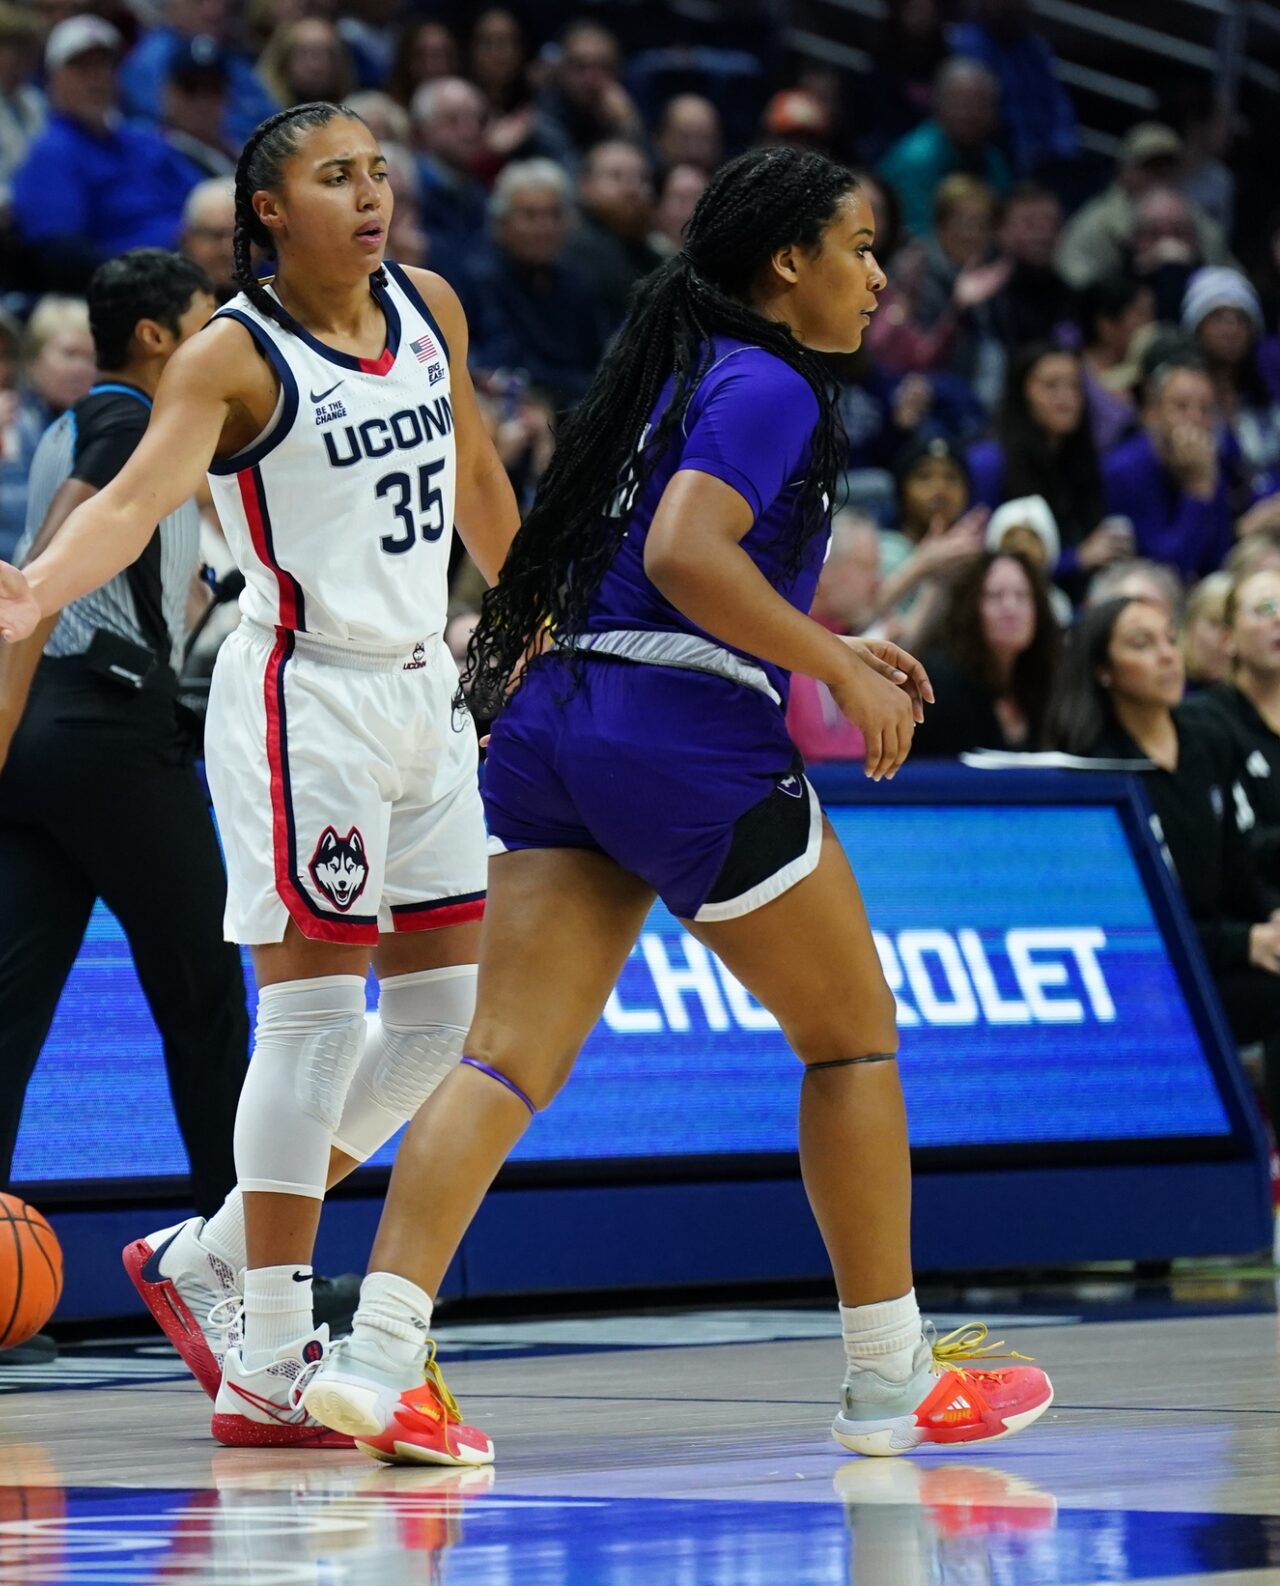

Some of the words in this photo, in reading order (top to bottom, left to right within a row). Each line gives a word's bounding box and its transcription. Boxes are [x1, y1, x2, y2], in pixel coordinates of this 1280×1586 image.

[427, 361, 440, 374] BIG
[429, 368, 444, 382] EAST
[315, 406, 327, 416] BE
[328, 400, 343, 411] THE
[315, 408, 347, 425] CHANGE
[323, 394, 455, 467] UCONN
[375, 456, 445, 554] 35
